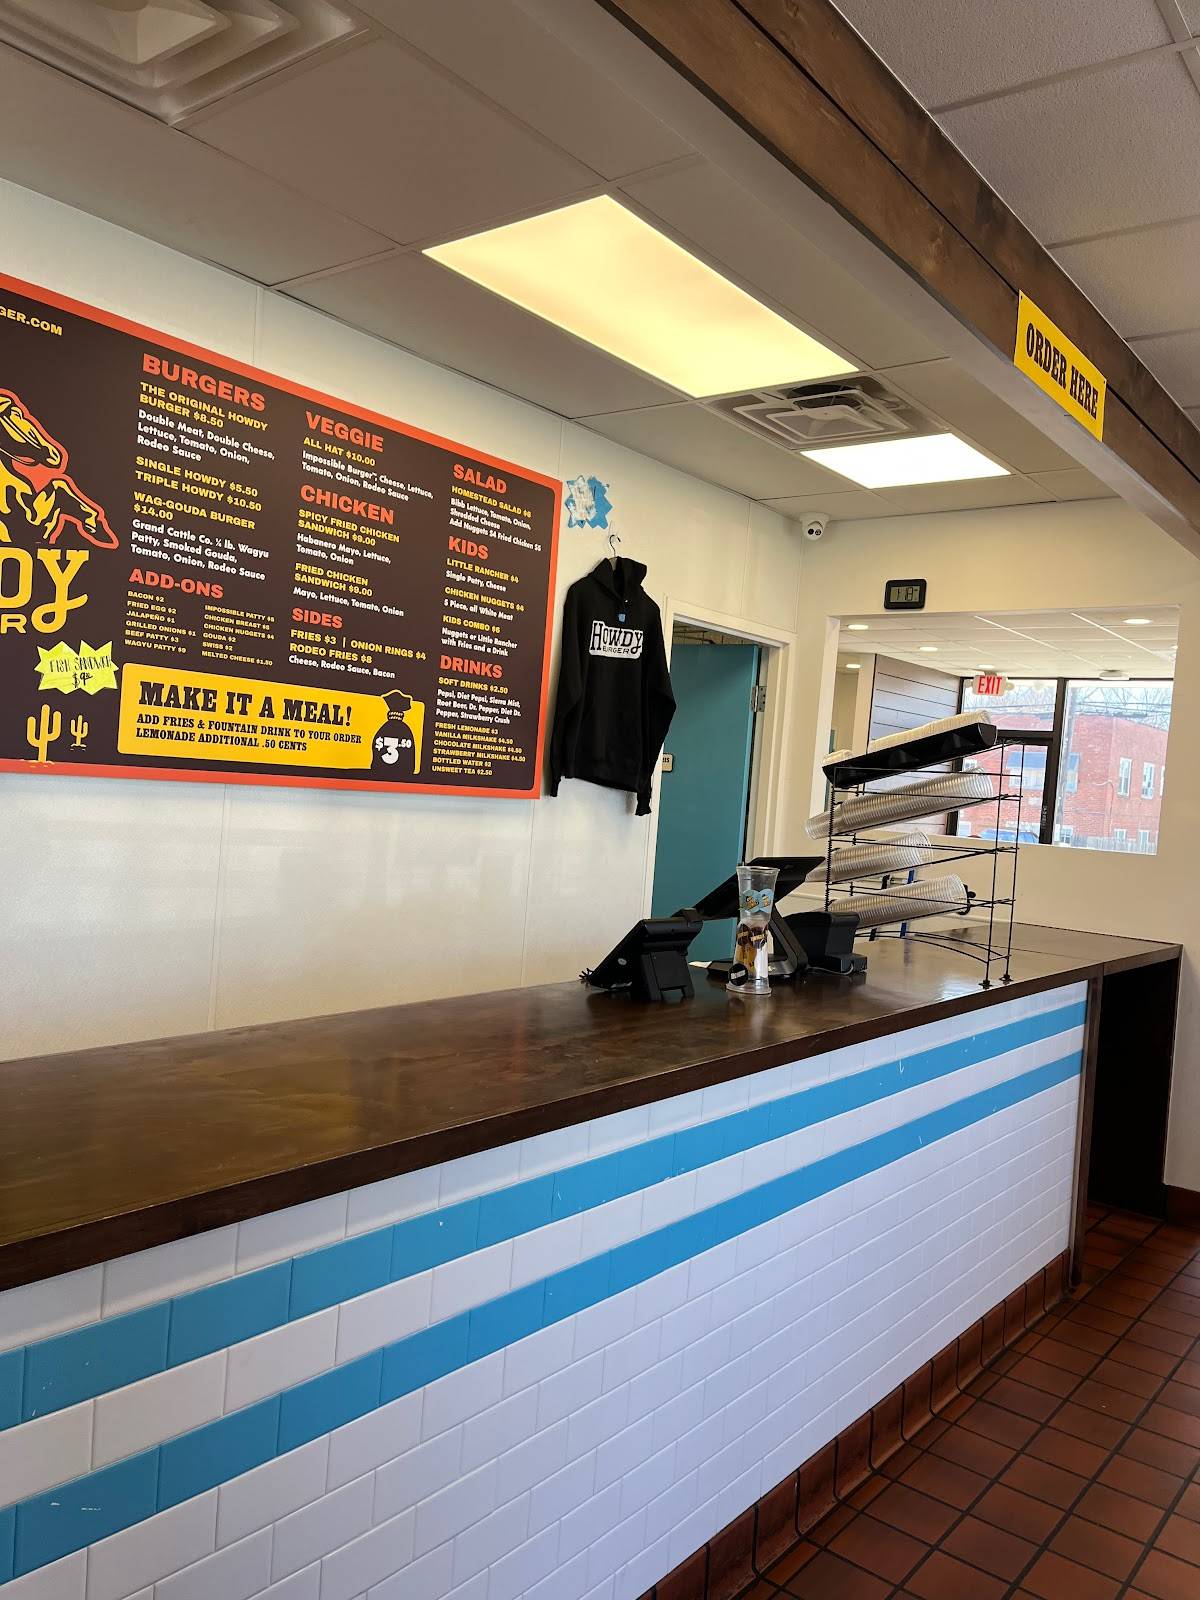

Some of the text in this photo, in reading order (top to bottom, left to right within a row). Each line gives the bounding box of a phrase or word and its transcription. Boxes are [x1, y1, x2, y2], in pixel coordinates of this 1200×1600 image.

[143, 353, 265, 411] BURGERS
[1026, 322, 1098, 420] ORDER HERE
[140, 382, 268, 431] THE ORIGINAL HOWDY
[140, 394, 224, 428] BURGER $8.50
[138, 409, 275, 460] Double Meat, Double Cheese,
[138, 422, 250, 464] Lettuce, Tomato, Onion,
[306, 411, 384, 452] VEGGIE
[138, 435, 201, 461] Rodeo Sauce
[303, 437, 375, 466] ALL HAT $10.00
[136, 456, 258, 497] SINGLE HOWDY $5.50
[302, 451, 433, 499] Impossible Cheese, Lettuce,
[302, 462, 409, 501] Tomato, Onion, Rodeo Sauce
[453, 464, 507, 494] SALAD
[135, 470, 262, 511] TRIPLE HOWDY $10.50
[300, 485, 394, 524] CHICKEN
[452, 486, 521, 514] HOMESTEAD SALAD
[134, 492, 255, 529] WAG-GOUDA BURGER
[134, 503, 173, 520] $14.00
[450, 508, 500, 529] Shredded Cheese
[132, 519, 269, 558] Grand Cattle Co. lb. Wagyu
[298, 509, 400, 542] SPICY FRIED CHICKEN
[298, 519, 375, 546] SANDWICH $9.00
[132, 531, 237, 563] Patty, Smoked Gouda,
[297, 533, 391, 564] Habanero Mayo, Lettuce,
[297, 544, 354, 565] Tomato, Onion
[448, 536, 489, 560] KIDS
[131, 544, 265, 580] Tomato, Onion, Rodeo Sauce
[295, 562, 368, 586] FRIED CHICKEN
[447, 558, 509, 580] LITTLE RANCHER
[129, 568, 224, 599] ADD-ONS
[295, 573, 372, 597] SANDWICH $9.00
[446, 570, 506, 591] Single Cheese
[127, 601, 149, 609] FRIED
[128, 591, 153, 600] BACON
[293, 587, 404, 616] Mayo, Lettuce, Tomato, Onion
[445, 587, 515, 610] CHICKEN NUGGETS
[126, 621, 186, 634] GRILLED ONIONS
[292, 607, 342, 629] SIDES
[443, 615, 490, 631] KIDS COMBO
[125, 639, 152, 648] WAGYU
[291, 629, 426, 660] FRIES $3 ONION RINGS $4
[442, 628, 468, 640] Nuggets
[494, 638, 517, 649] Rancher
[474, 644, 508, 656] and Drink
[289, 655, 395, 678] Cheese, Rodeo Sauce, Bacon
[290, 643, 372, 664] RODEO FRIES $8
[440, 655, 503, 679] DRINKS
[438, 677, 488, 691] SOFT DRINKS
[978, 676, 1002, 694] EXIT
[139, 681, 352, 726] MAKE IT A MEAL!
[136, 727, 307, 751] LEMONADE ADDITIONAL .50 CENTS
[137, 714, 361, 743] ADD FRIES & FOUNTAIN DRINK TO YOUR ORDER
